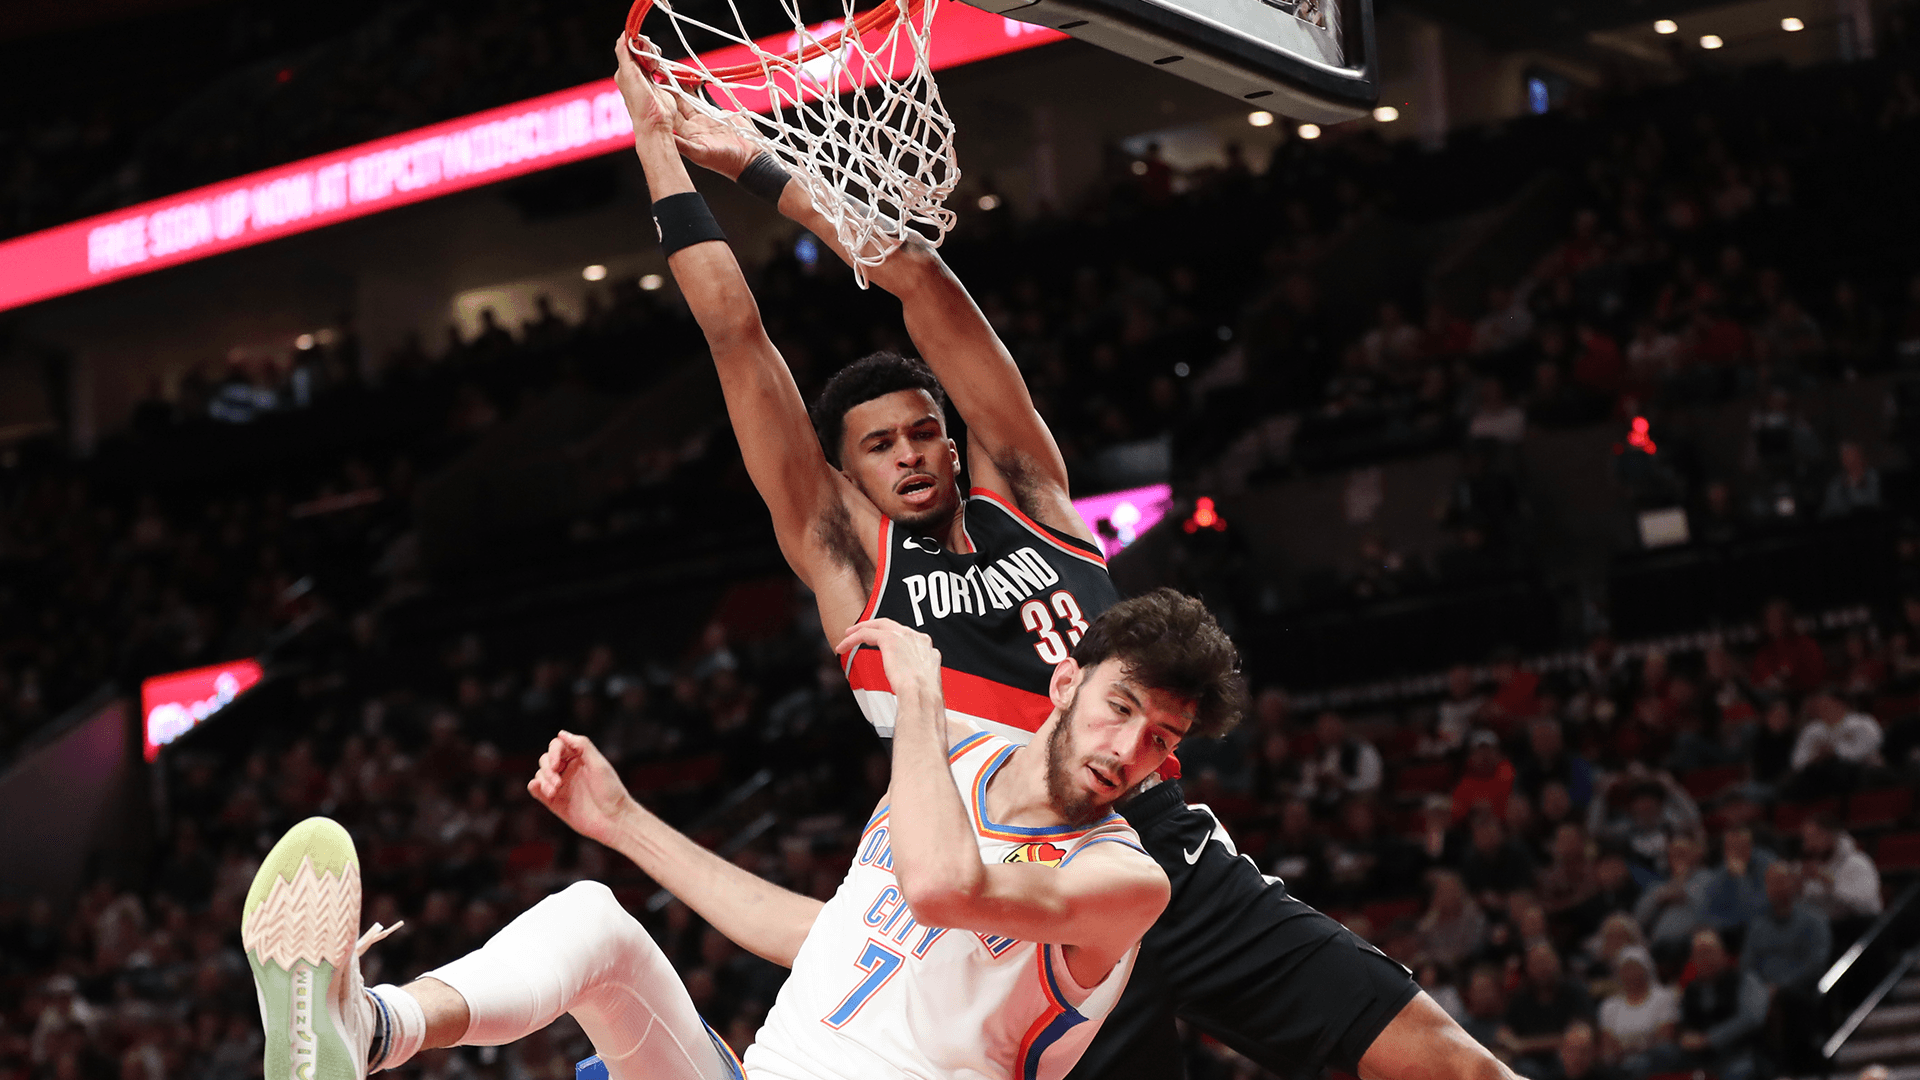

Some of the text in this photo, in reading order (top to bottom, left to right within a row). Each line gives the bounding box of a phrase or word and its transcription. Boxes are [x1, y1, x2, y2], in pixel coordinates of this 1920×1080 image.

[88, 88, 634, 274] FREE SIGN UP NOW AT RIPCITYKIDSCLUB.CO
[902, 546, 1060, 627] PORTLAND
[1020, 589, 1090, 665] 33
[821, 937, 906, 1030] 7
